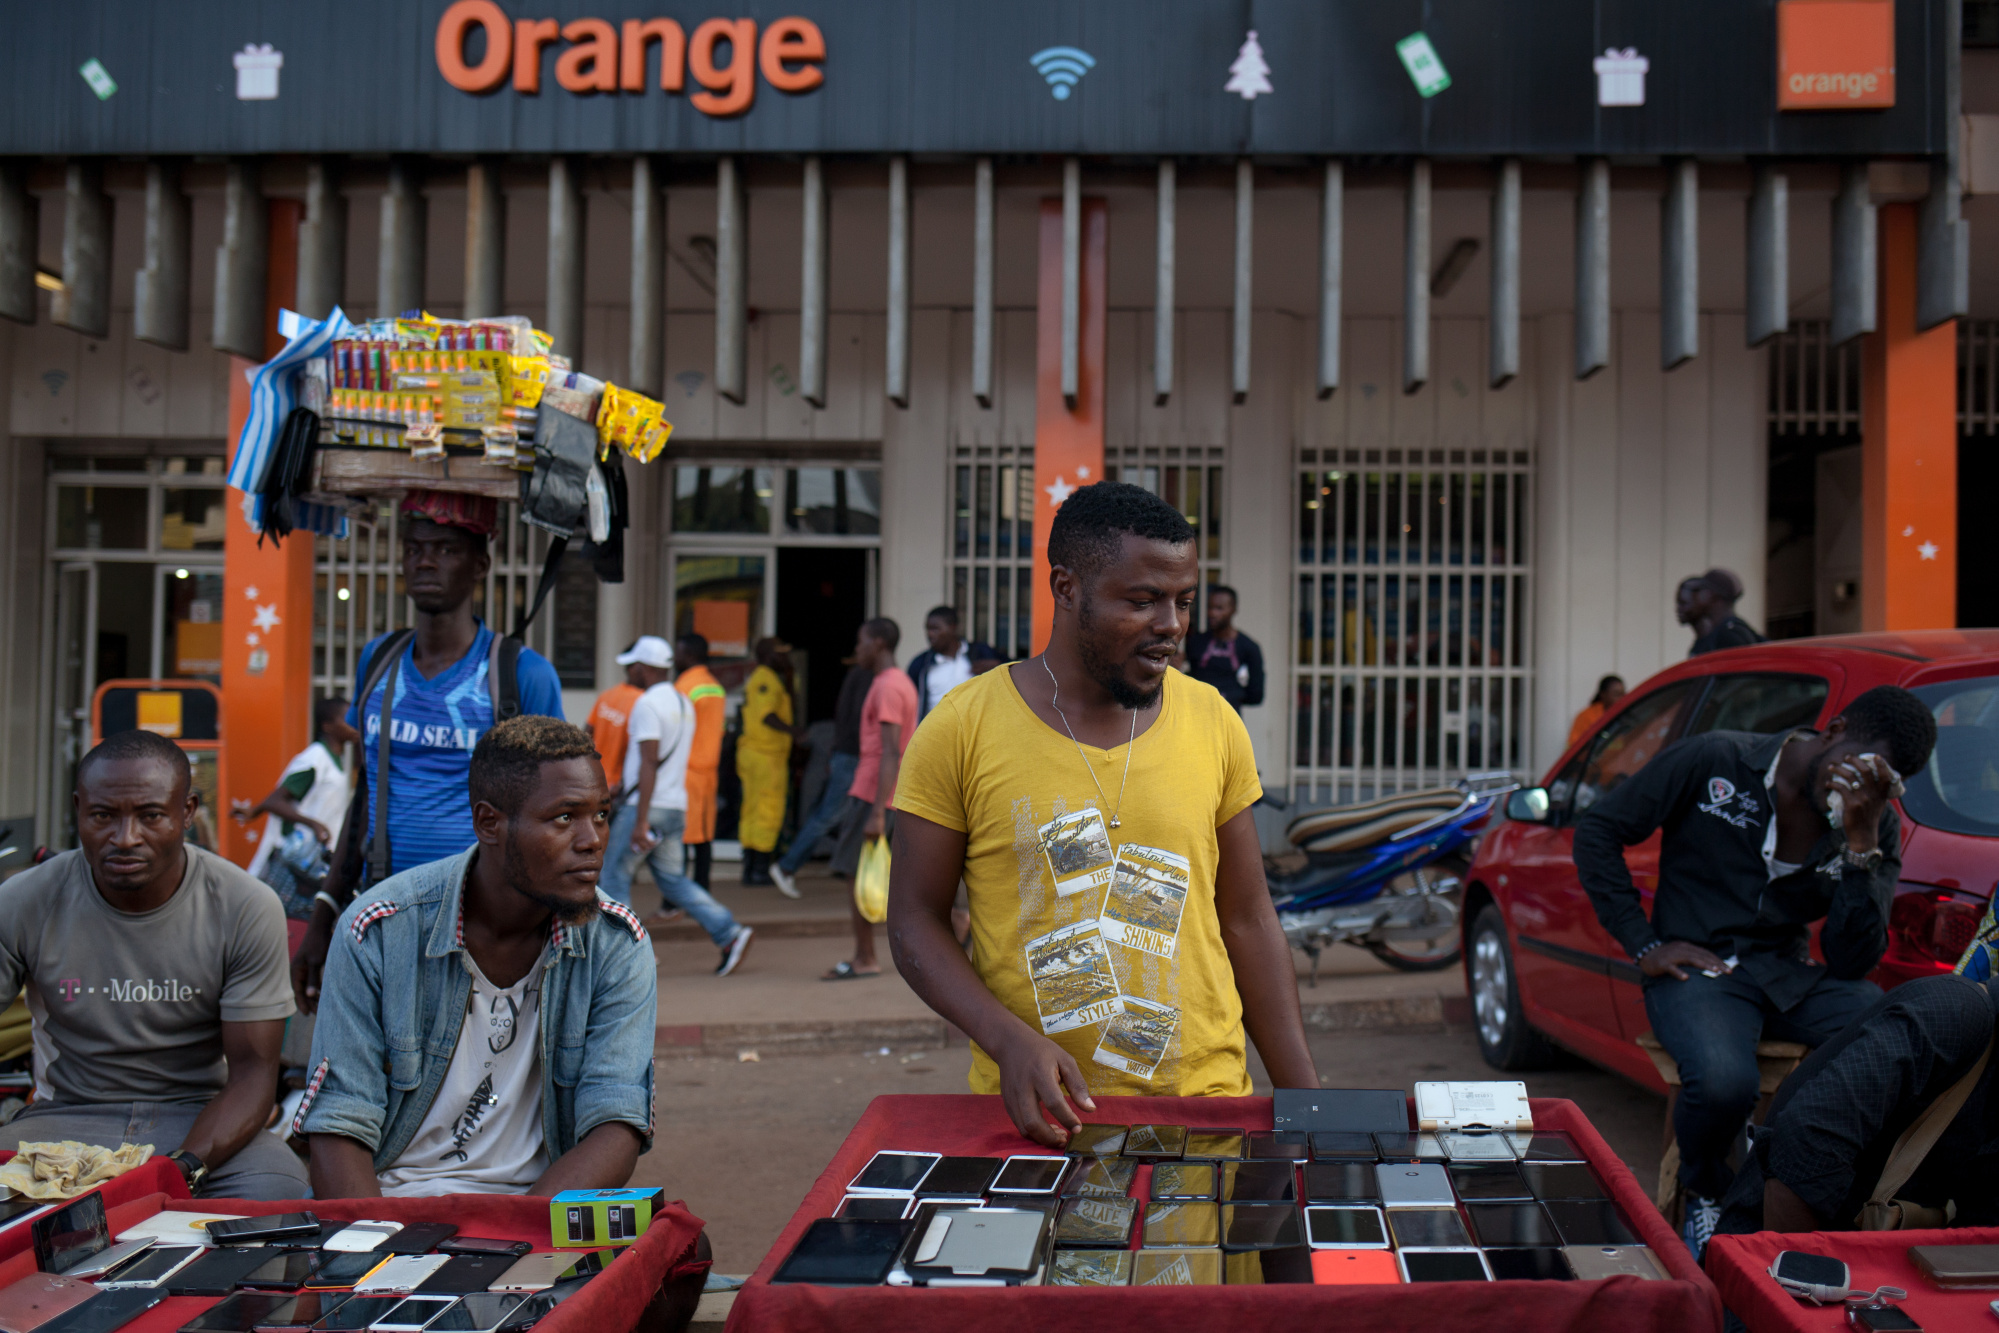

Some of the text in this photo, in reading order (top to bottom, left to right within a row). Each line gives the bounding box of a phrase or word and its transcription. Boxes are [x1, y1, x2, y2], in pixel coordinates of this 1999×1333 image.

[434, 0, 827, 117] Orange
[1789, 72, 1878, 99] orange
[366, 713, 419, 745] GLD
[1089, 868, 1111, 885] THE
[1121, 925, 1172, 955] SHINING
[1078, 1000, 1117, 1023] STYLE
[1126, 1060, 1151, 1077] WATER
